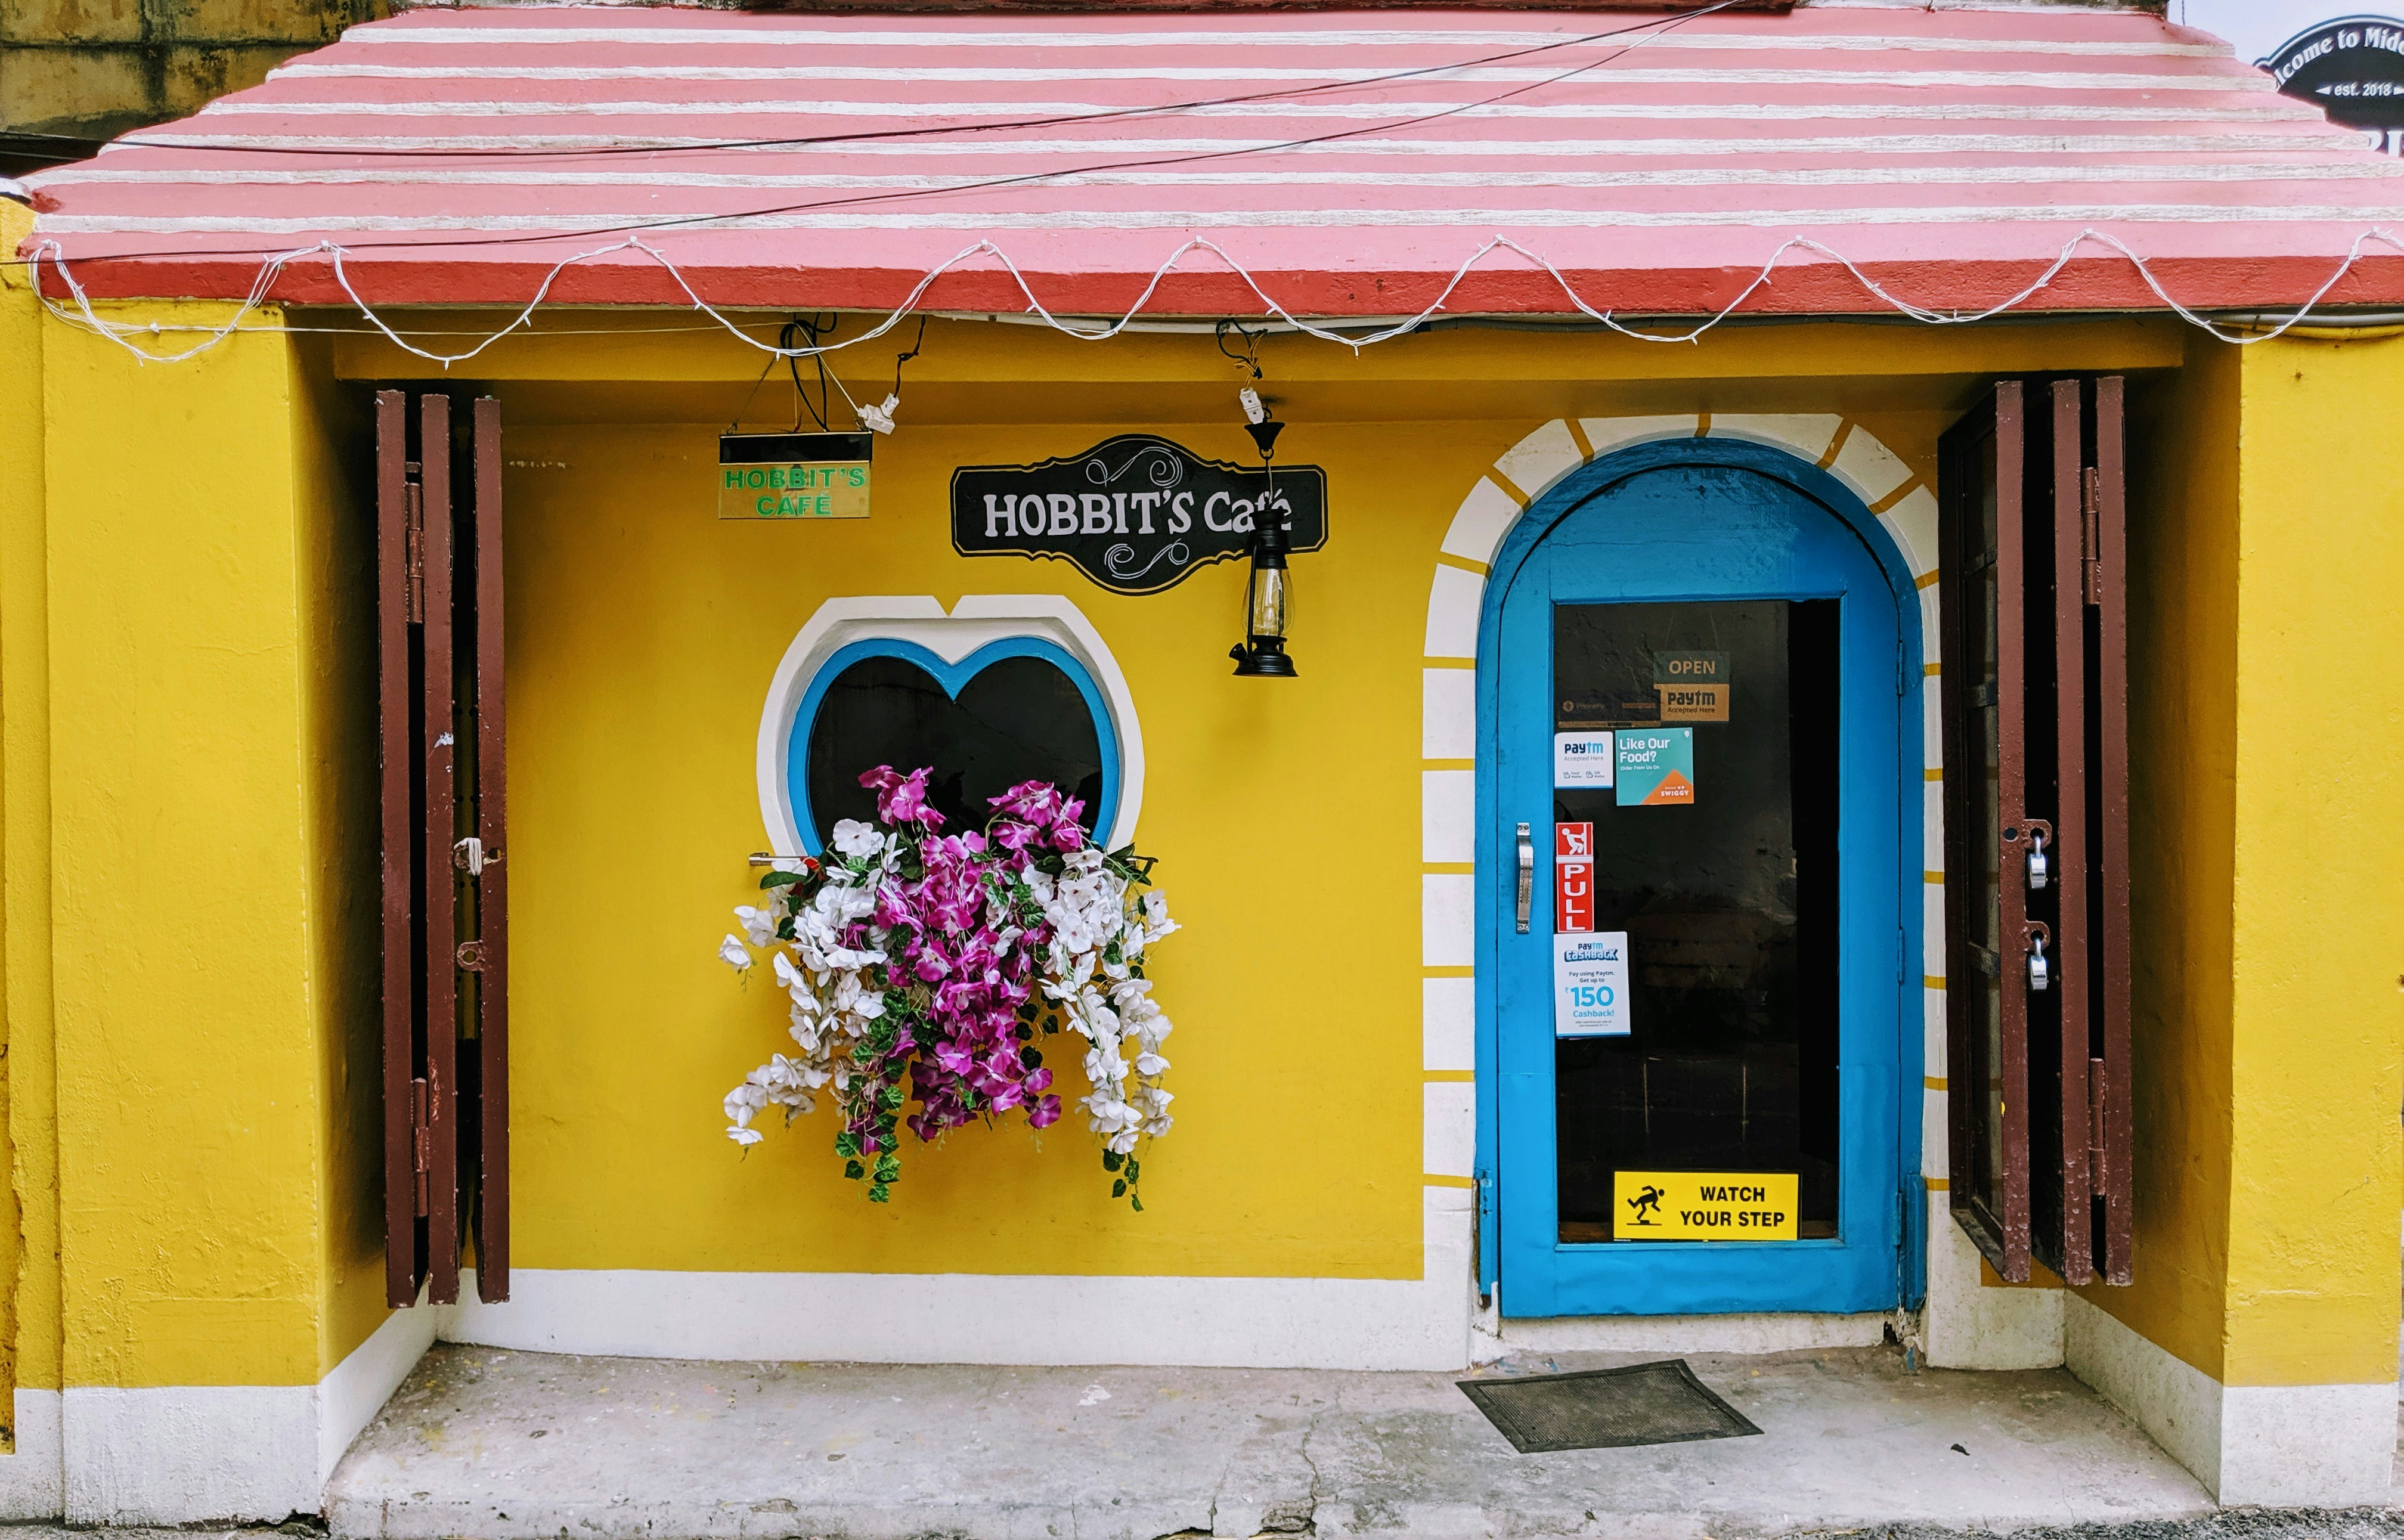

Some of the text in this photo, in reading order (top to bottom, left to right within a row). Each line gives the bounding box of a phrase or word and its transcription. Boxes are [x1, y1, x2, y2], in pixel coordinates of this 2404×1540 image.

[2273, 36, 2333, 89] lcome
[2337, 29, 2359, 49] to
[2334, 84, 2393, 97] est. 2018
[724, 467, 866, 489] HOBBIT'S
[755, 490, 832, 517] CAFÉ
[983, 487, 1194, 537] HOBBIT'S
[1668, 660, 1716, 675] OPEN
[1619, 737, 1671, 750] Like Our
[1619, 750, 1658, 764] Food?
[1564, 864, 1586, 931] PULL
[1573, 1009, 1615, 1018] Cashback!
[1700, 1186, 1765, 1202] WATCH
[1680, 1211, 1785, 1227] YOUR STEP
